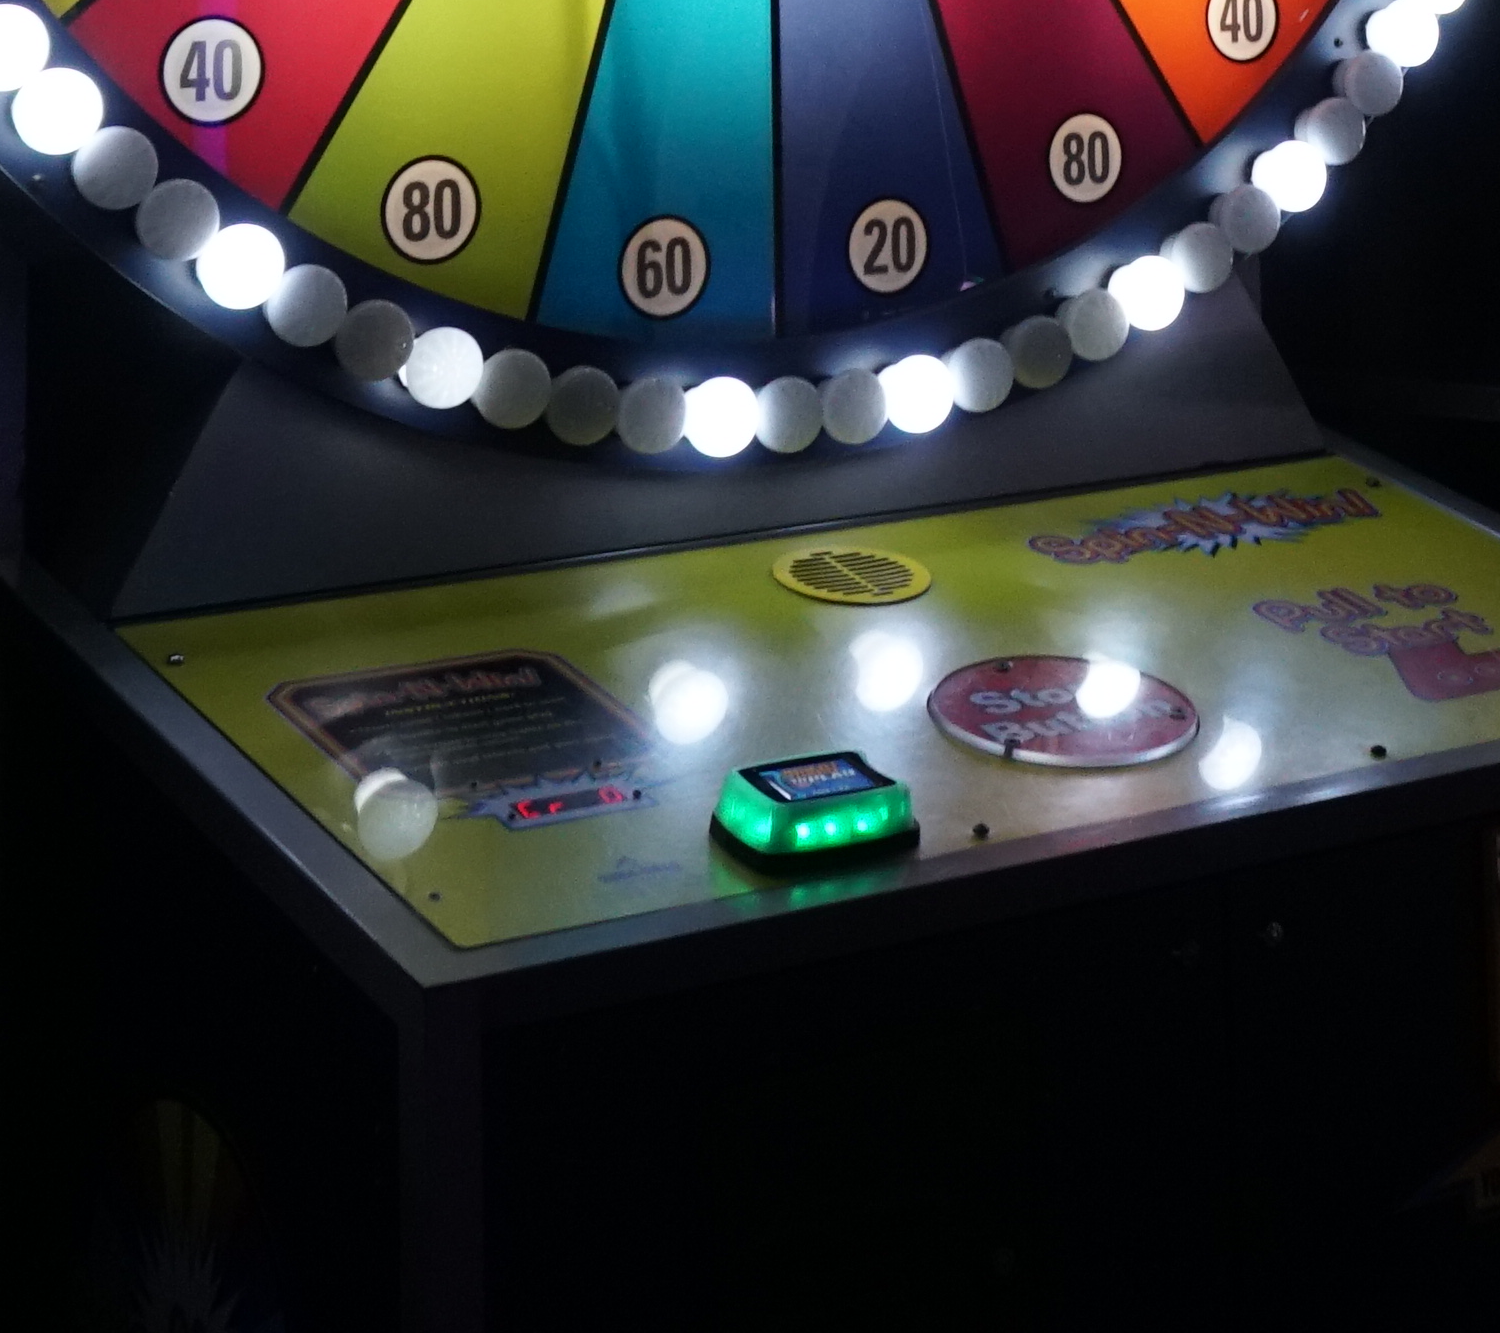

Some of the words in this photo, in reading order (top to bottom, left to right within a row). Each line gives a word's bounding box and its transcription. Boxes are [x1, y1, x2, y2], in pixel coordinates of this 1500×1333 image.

[179, 41, 242, 102] 40
[1063, 131, 1109, 186] 80
[403, 179, 461, 242] 80
[636, 237, 691, 299] 60
[864, 217, 915, 275] 20
